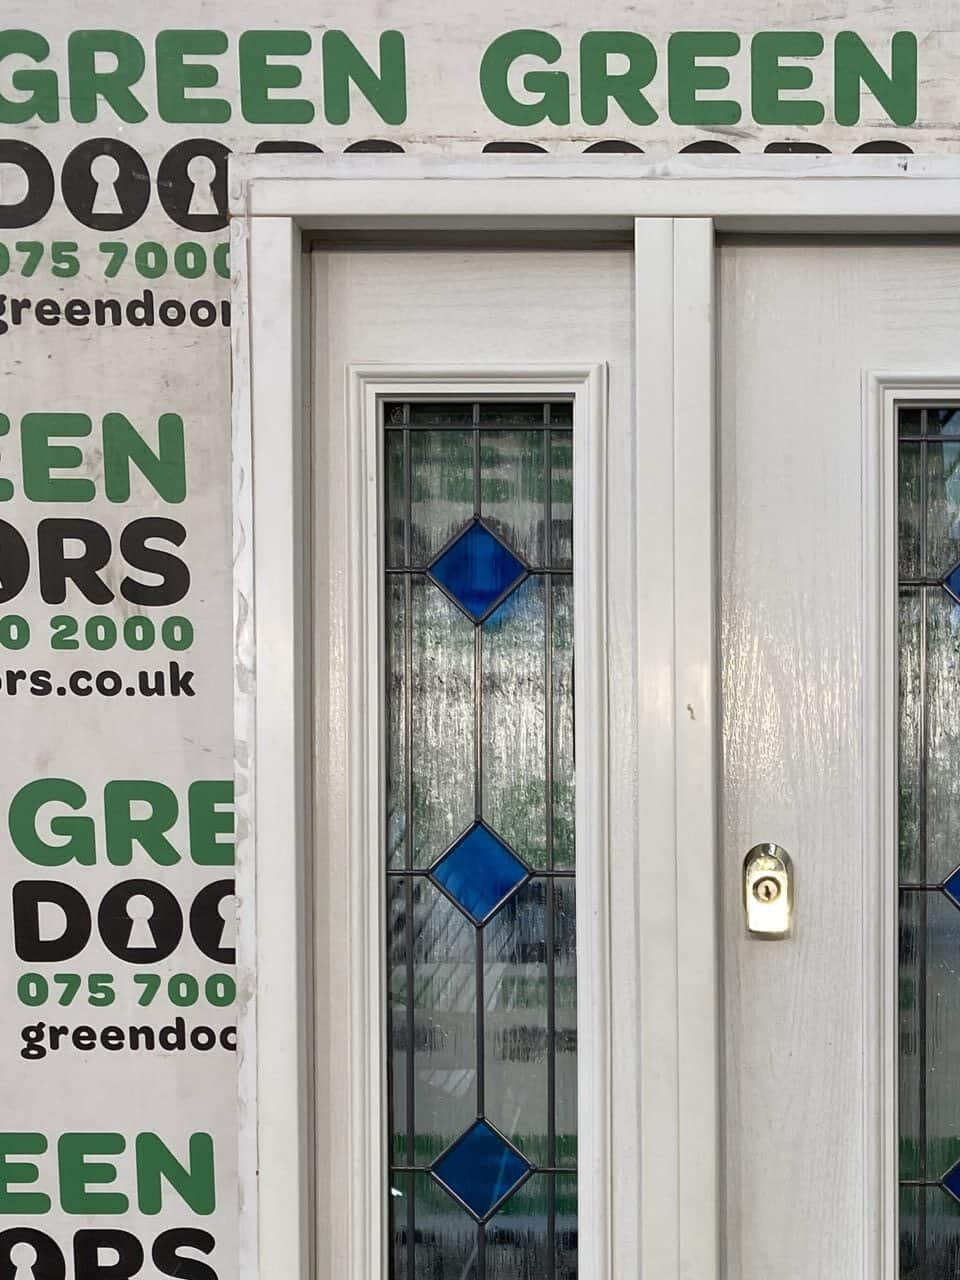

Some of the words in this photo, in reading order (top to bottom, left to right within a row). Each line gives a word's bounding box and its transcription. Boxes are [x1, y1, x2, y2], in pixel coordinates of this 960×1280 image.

[0, 29, 407, 125] GREEN
[479, 29, 918, 127] GREEN
[0, 241, 80, 279] 75
[0, 413, 187, 504] EN
[50, 615, 194, 651] 2000
[17, 973, 116, 1007] 075
